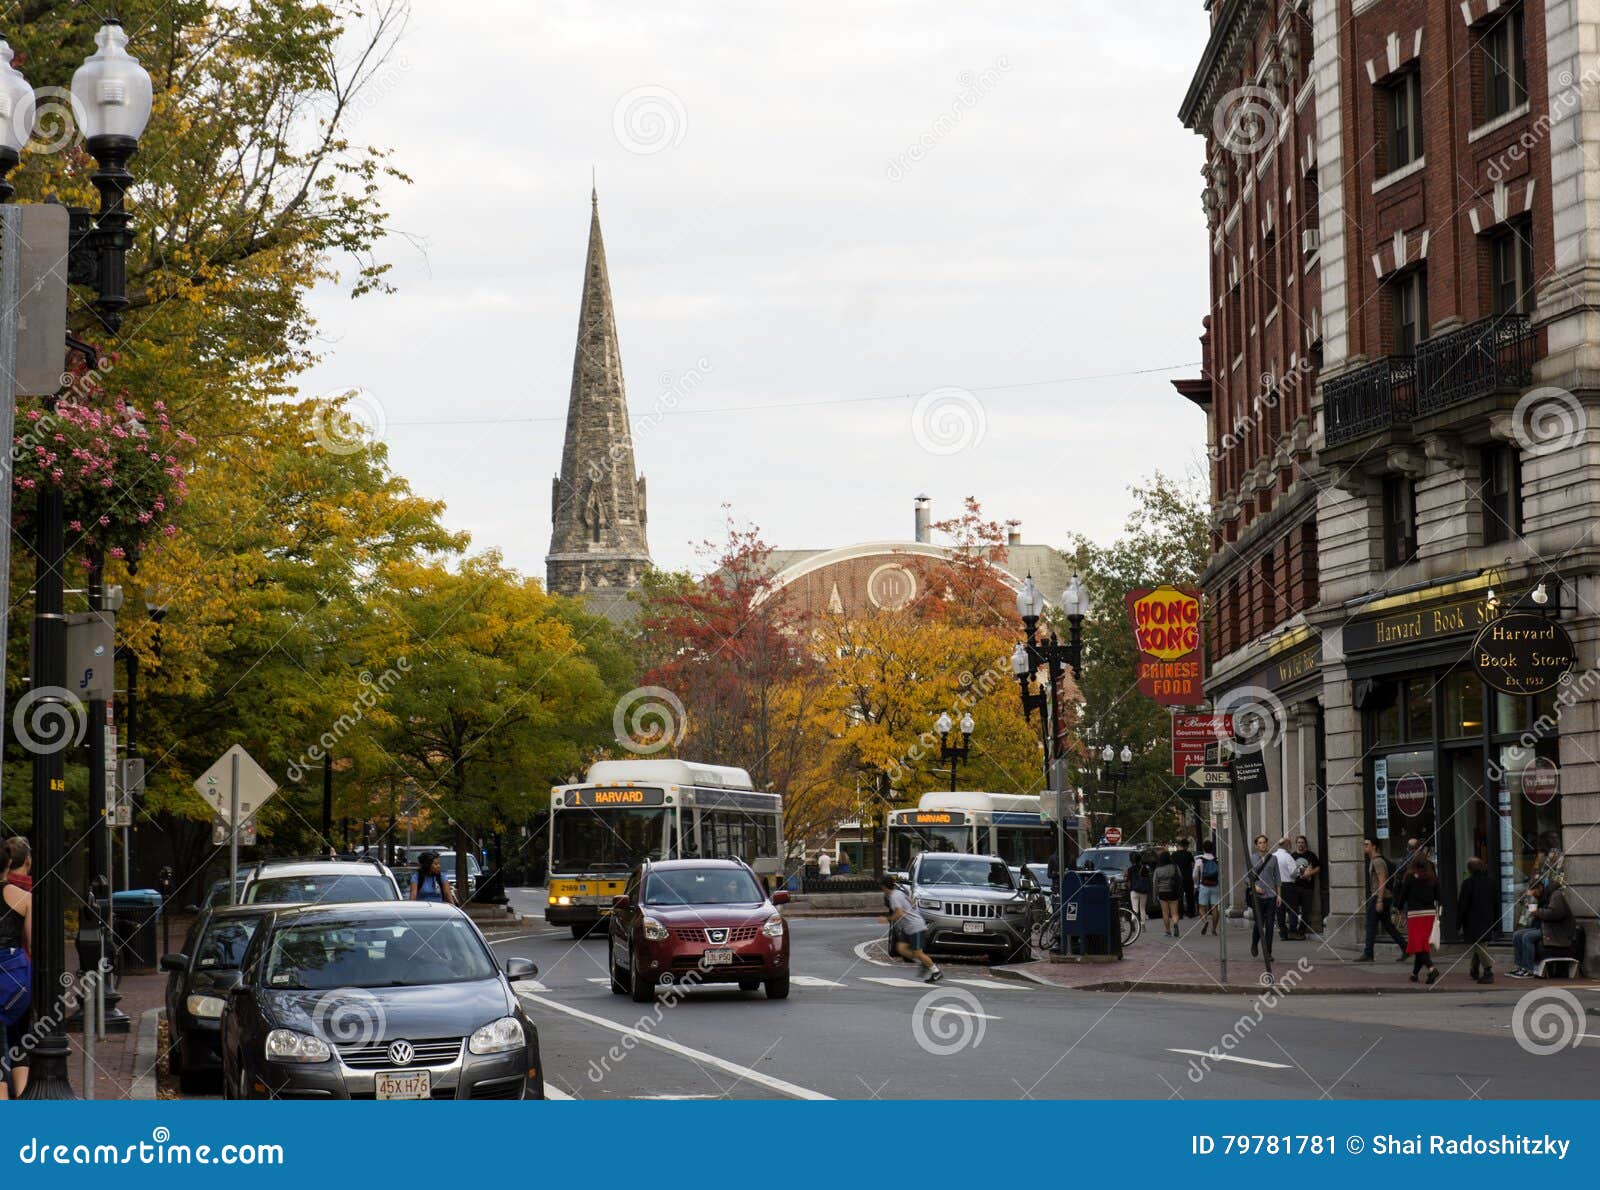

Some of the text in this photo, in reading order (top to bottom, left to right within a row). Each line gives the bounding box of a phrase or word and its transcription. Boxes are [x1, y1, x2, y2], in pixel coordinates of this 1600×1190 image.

[1136, 600, 1197, 626] HONG
[1376, 614, 1421, 643] Harvard
[1433, 607, 1464, 632] Book
[1136, 626, 1199, 651] KONG
[1492, 626, 1554, 641] Harvard
[1480, 651, 1569, 667] Book Store
[1141, 663, 1199, 678] CHINESE
[1154, 679, 1192, 696] FOOD
[1205, 773, 1224, 782] ONE
[575, 791, 643, 805] 1 HARVARD
[916, 814, 951, 823] HARVARD
